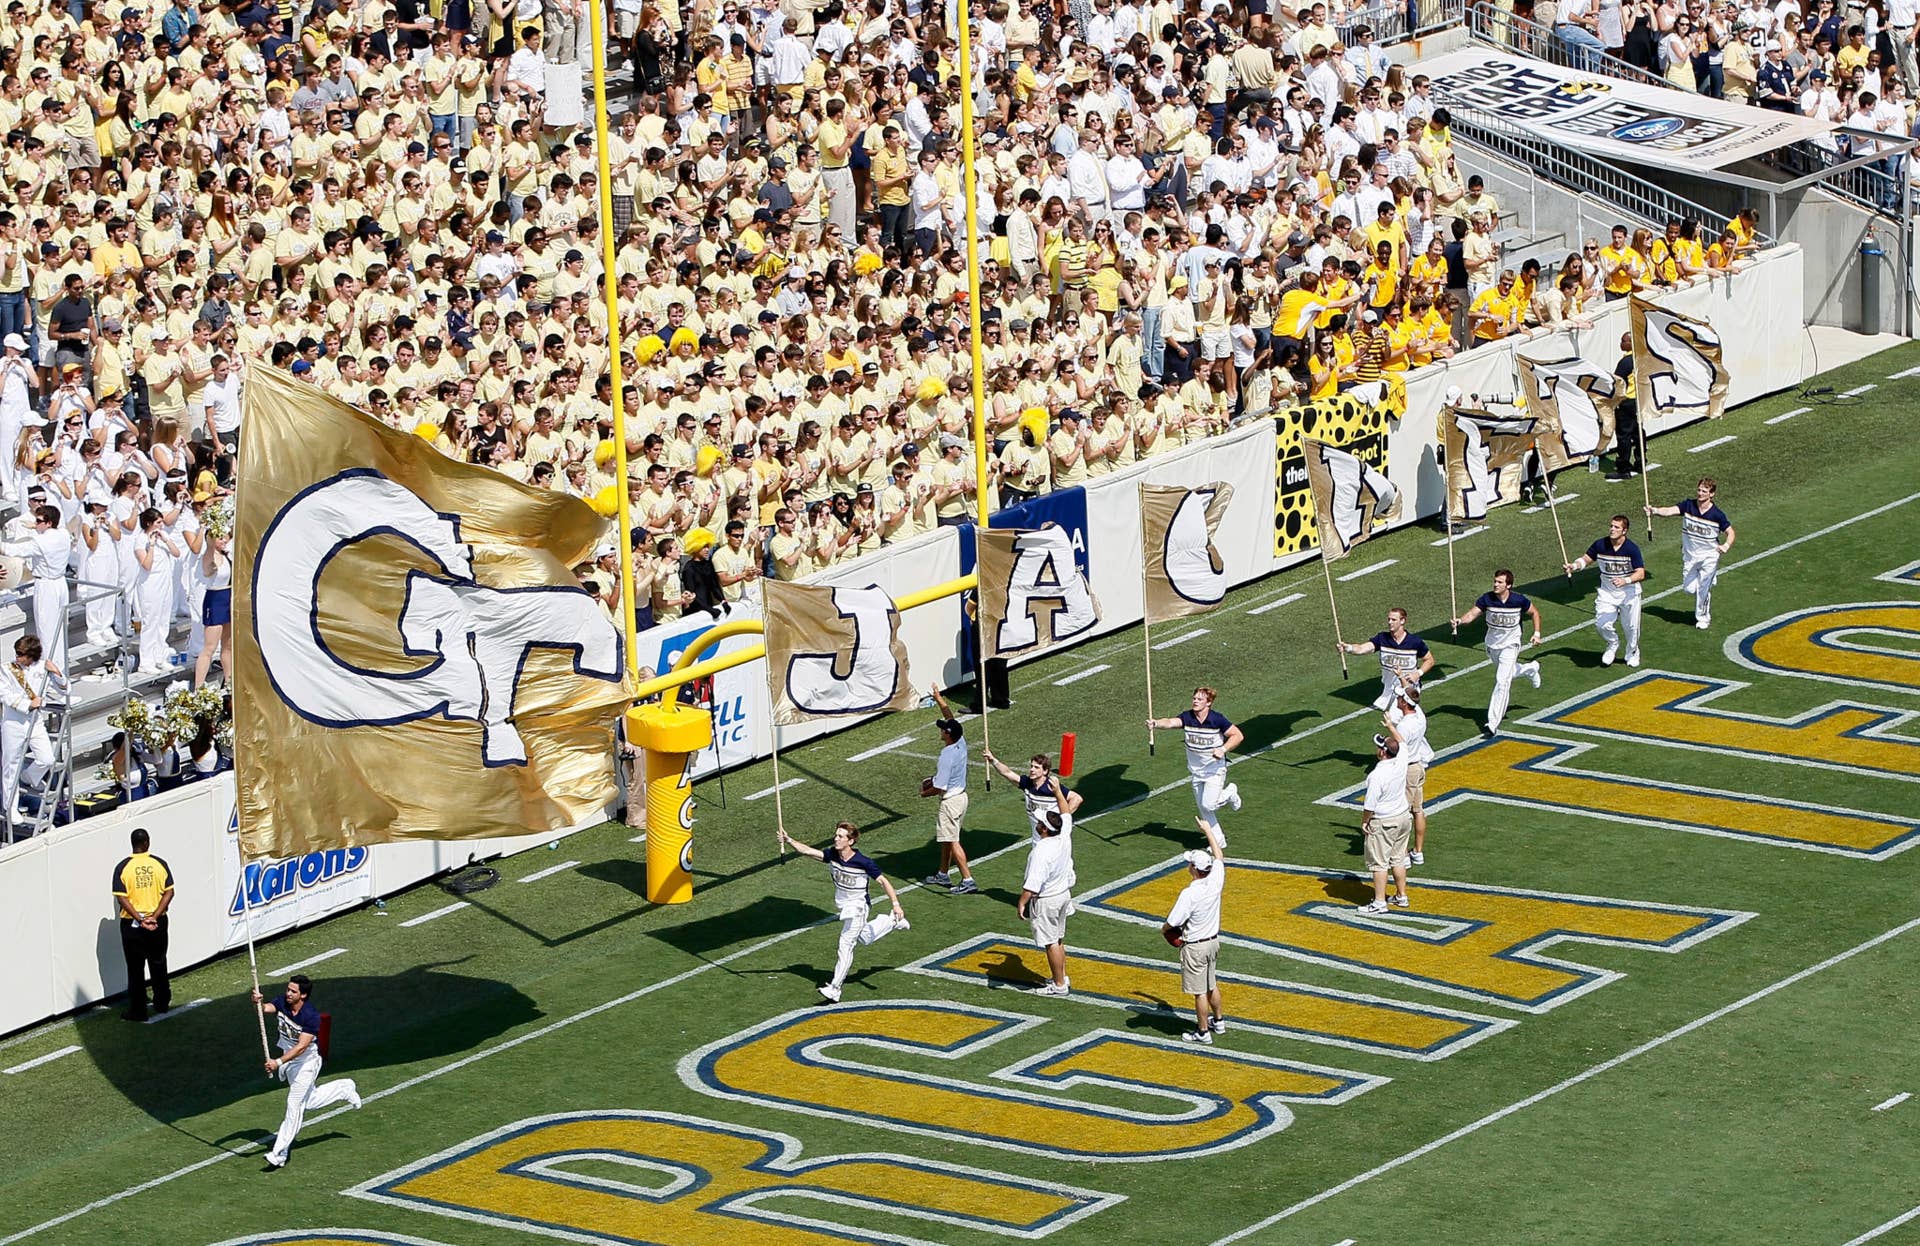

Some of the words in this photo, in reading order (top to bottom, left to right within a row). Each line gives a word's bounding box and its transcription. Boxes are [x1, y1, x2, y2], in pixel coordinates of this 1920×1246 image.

[1551, 104, 1650, 134] BUILT
[787, 585, 900, 714] J
[996, 525, 1099, 653] A
[1643, 310, 1721, 411] S
[252, 467, 623, 770] GT
[135, 865, 153, 876] CSC
